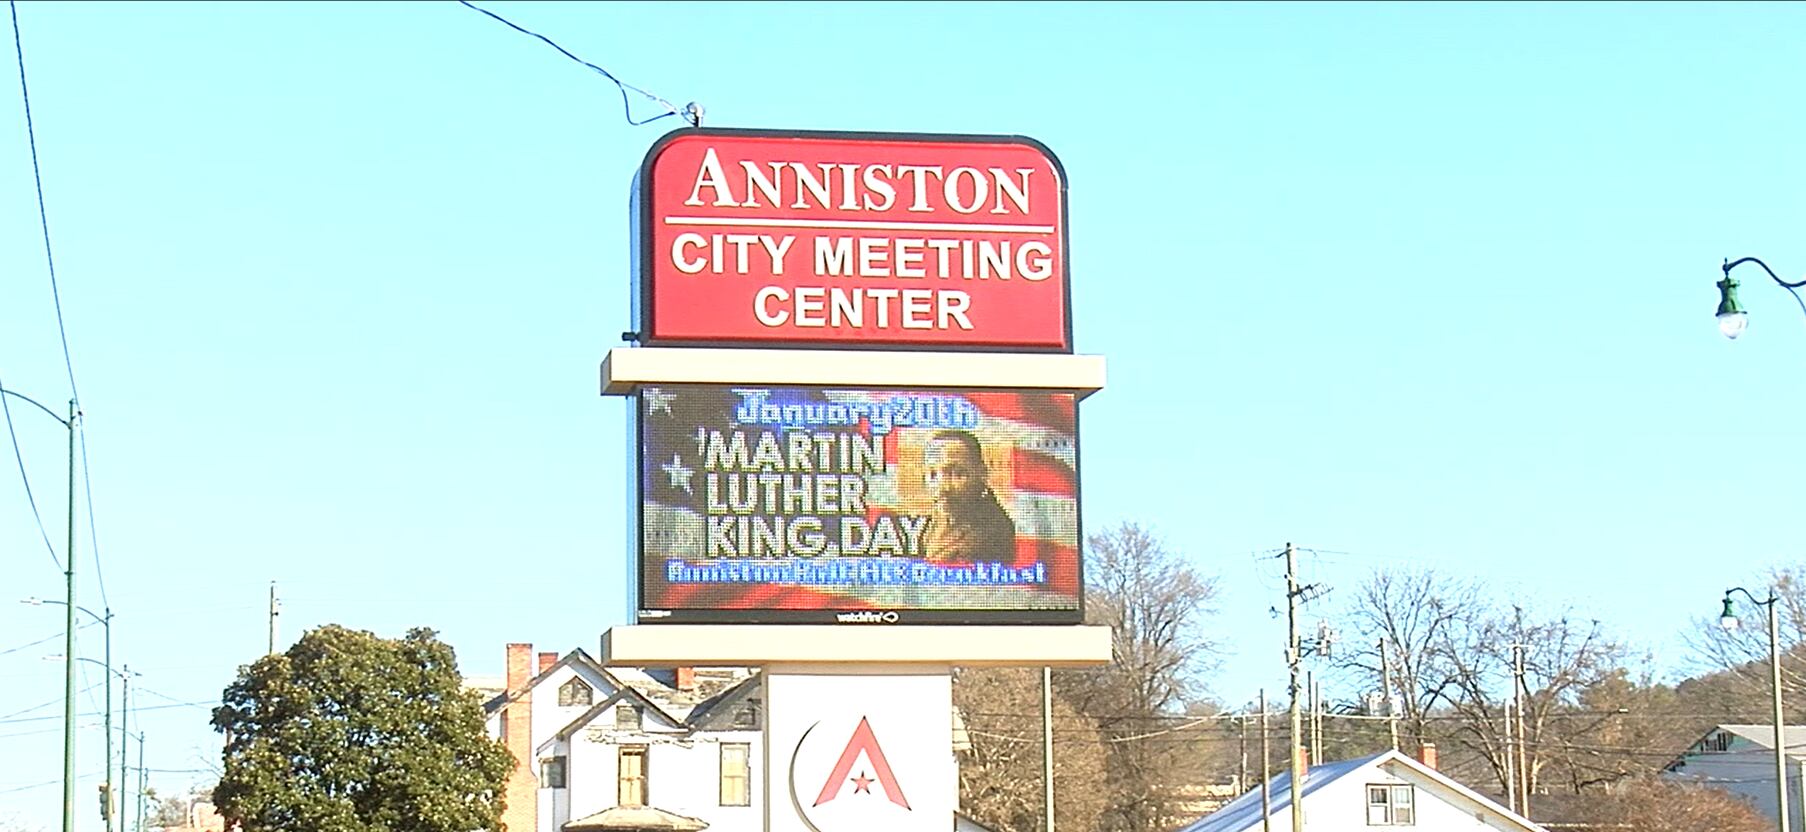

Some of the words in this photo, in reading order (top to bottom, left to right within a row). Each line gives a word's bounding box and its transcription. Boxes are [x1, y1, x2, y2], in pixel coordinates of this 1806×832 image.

[684, 147, 1035, 215] ANNISTON
[671, 233, 796, 275] CITY
[813, 236, 1054, 281] MEETING
[754, 286, 974, 330] CENTER
[704, 430, 885, 472] MARTIN
[706, 473, 868, 514] LUTHER
[706, 515, 828, 557] KING
[839, 516, 929, 556] DAY
